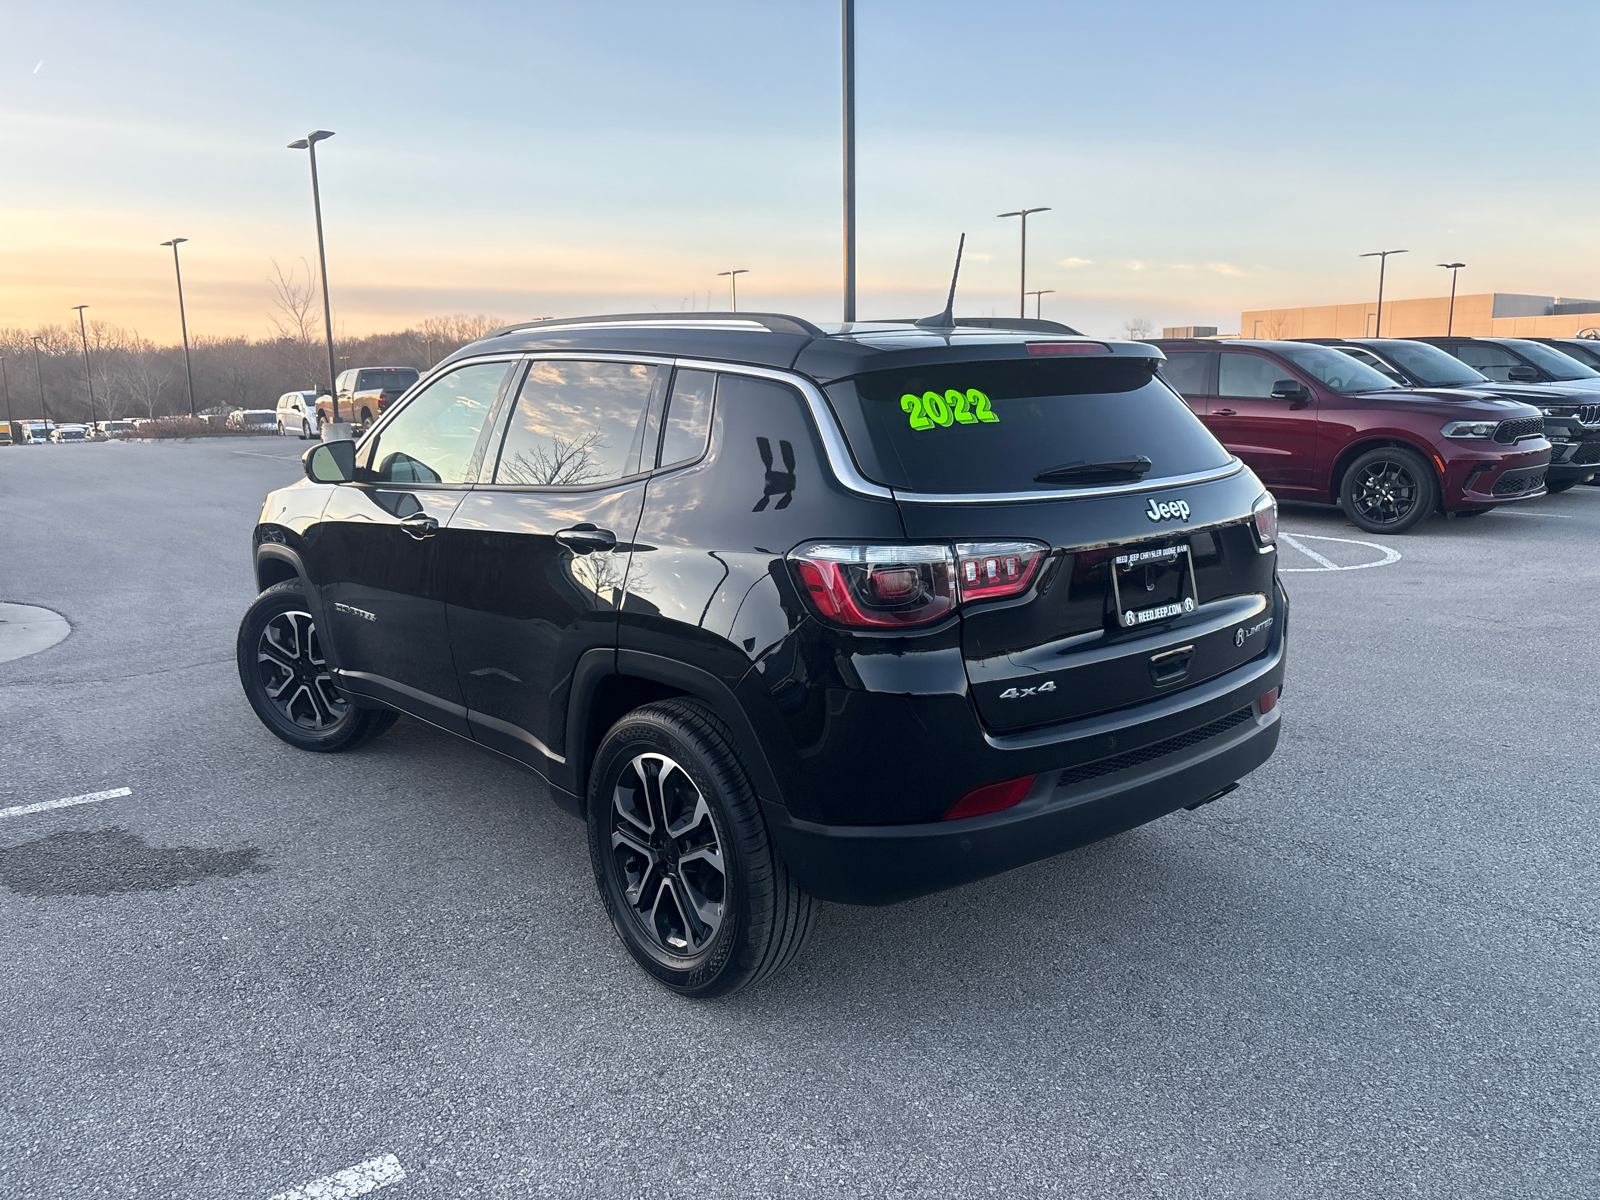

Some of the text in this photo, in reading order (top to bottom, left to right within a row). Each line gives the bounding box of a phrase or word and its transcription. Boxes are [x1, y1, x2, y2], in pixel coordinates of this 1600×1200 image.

[900, 388, 1000, 431] 2022
[1145, 498, 1191, 523] Jeep
[1115, 544, 1188, 565] REED JEEP CHRYSLER DODGE RAM
[1138, 603, 1182, 623] REEDJEEP.COM
[999, 680, 1057, 699] 4x4
